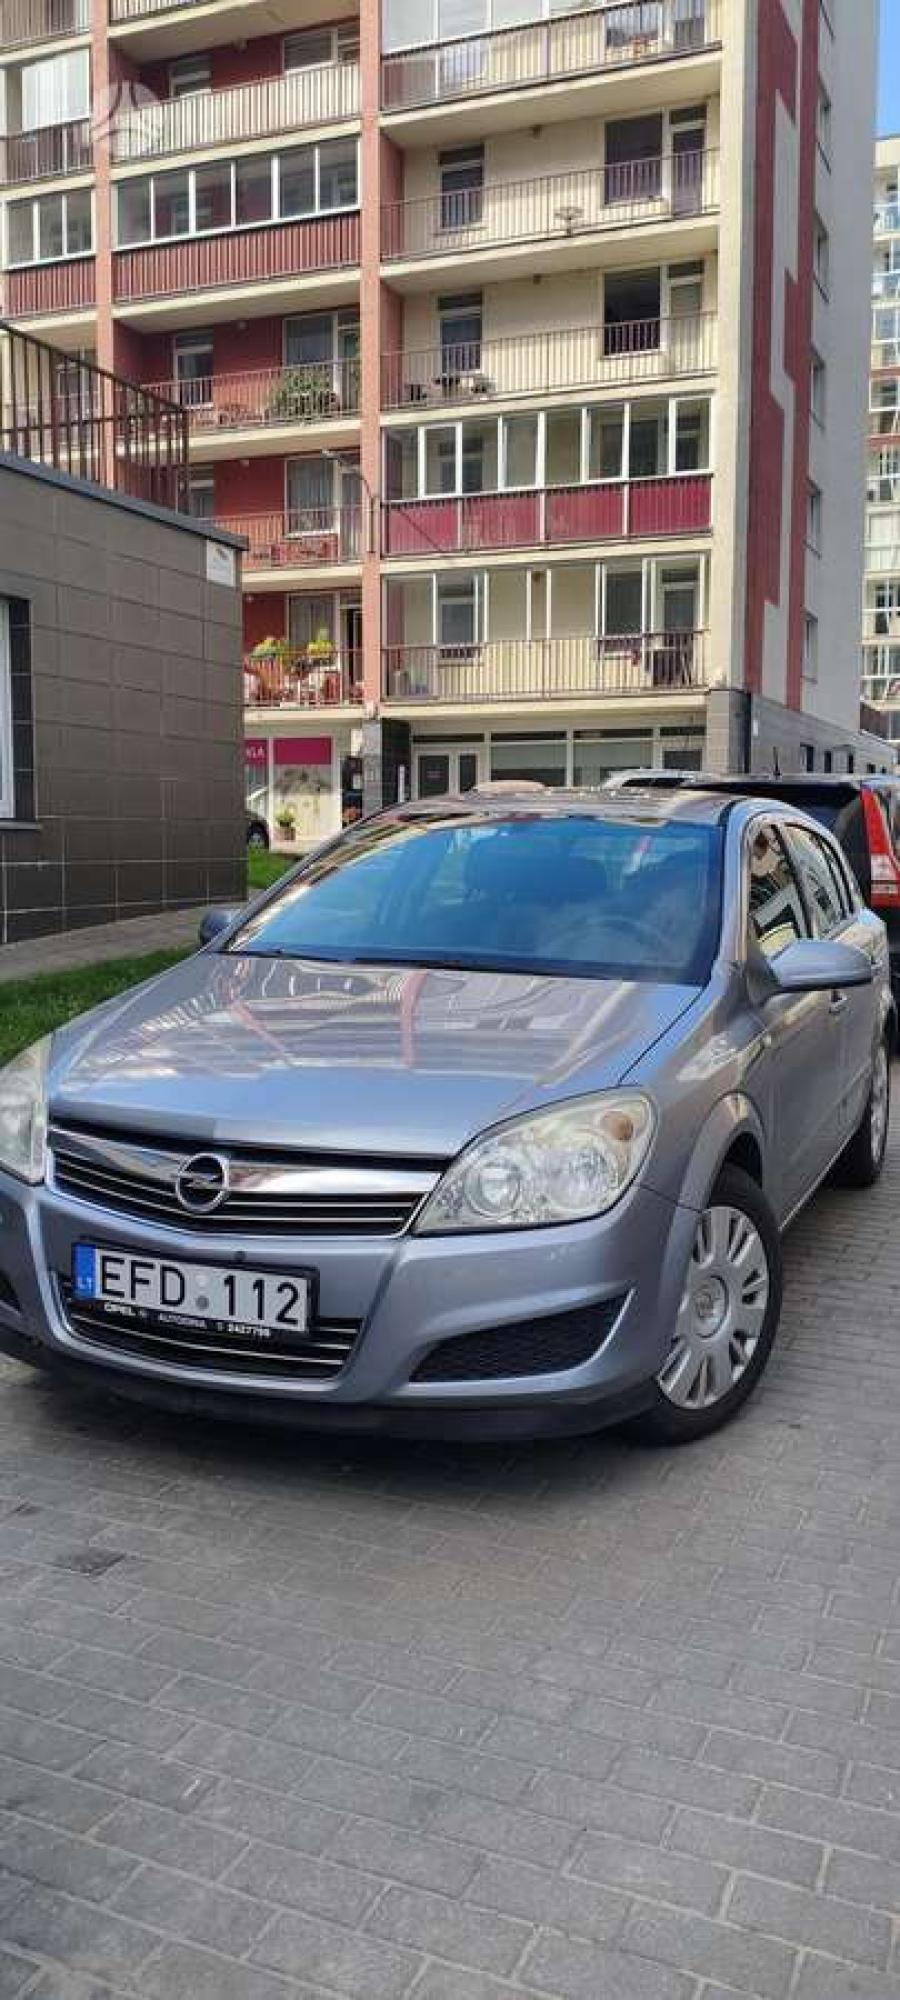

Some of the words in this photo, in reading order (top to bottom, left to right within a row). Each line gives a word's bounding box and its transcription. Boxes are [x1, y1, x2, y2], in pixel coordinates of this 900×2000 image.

[77, 1276, 92, 1290] LT
[101, 1254, 186, 1307] EFD
[223, 1274, 299, 1325] 112
[104, 1301, 136, 1317] OPEL
